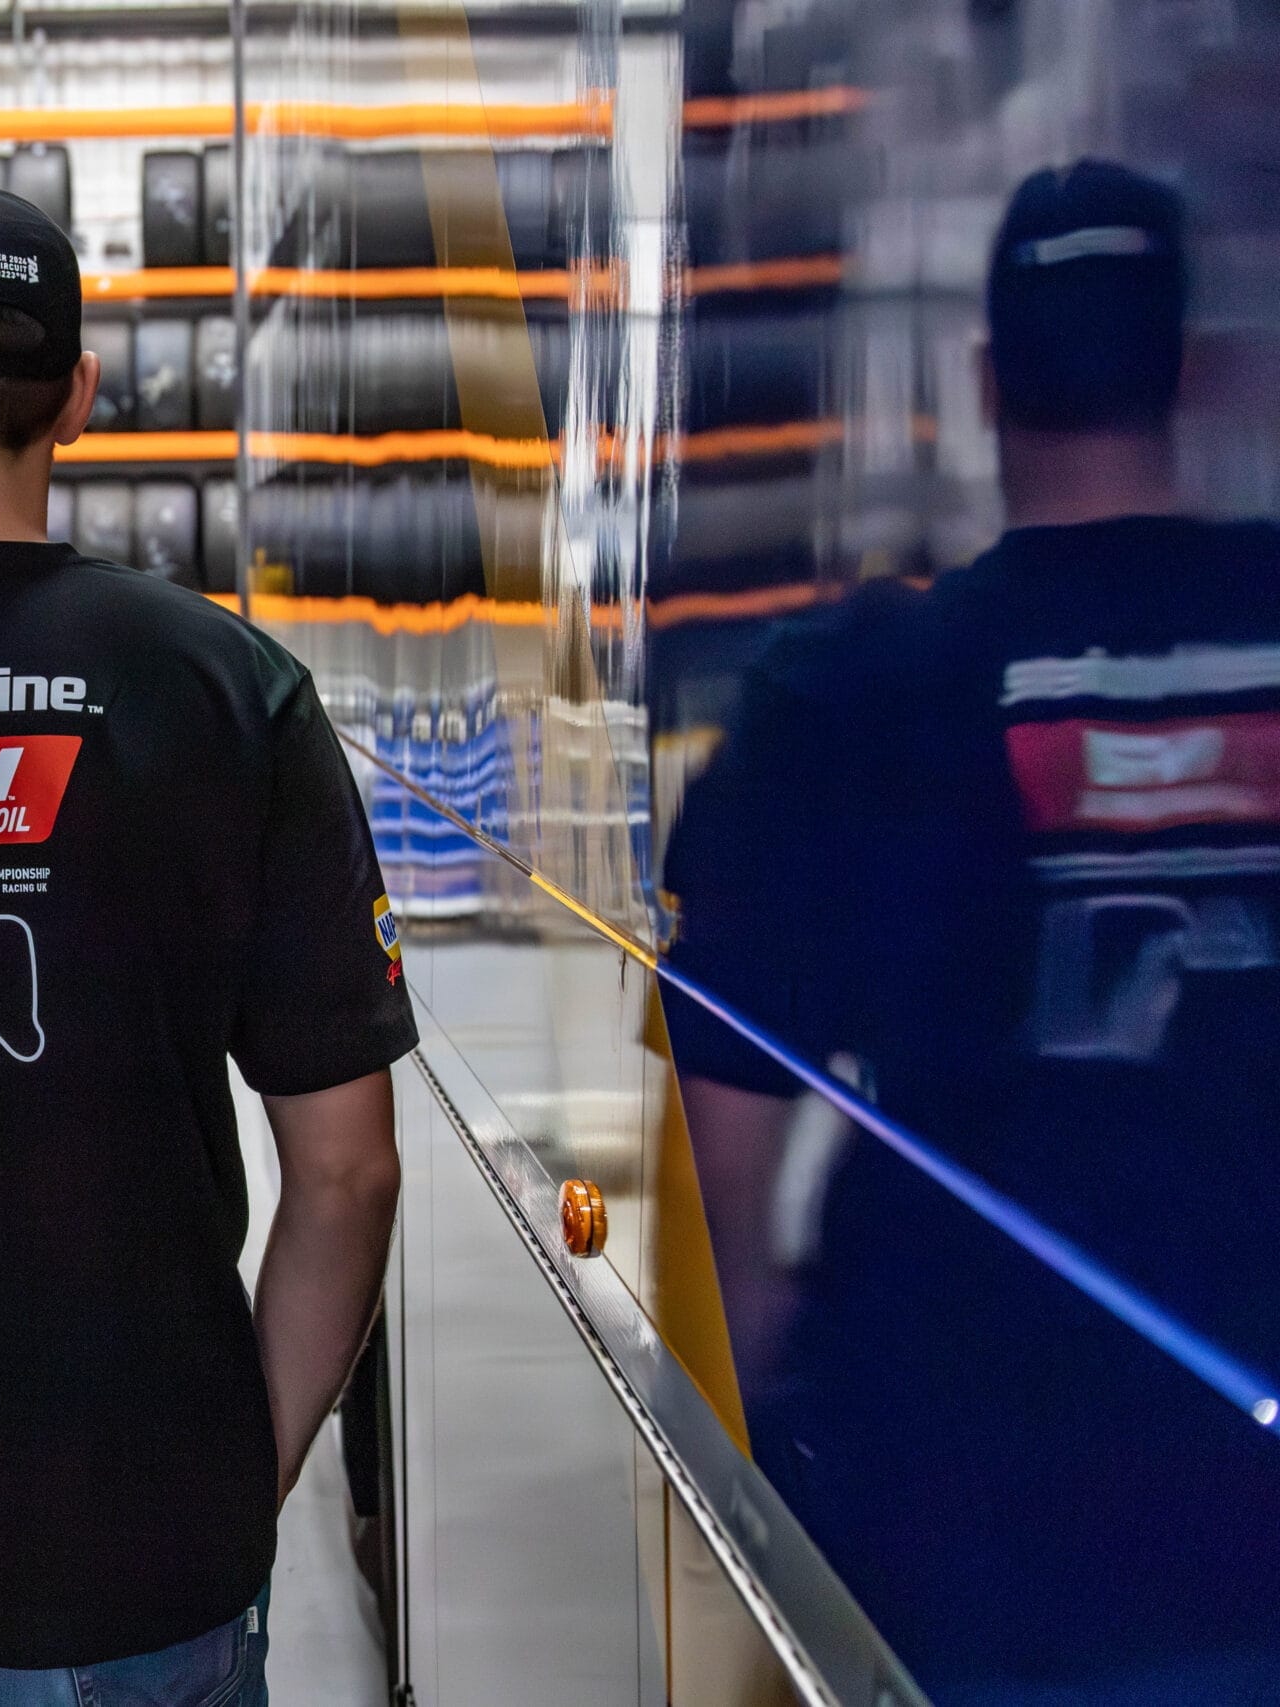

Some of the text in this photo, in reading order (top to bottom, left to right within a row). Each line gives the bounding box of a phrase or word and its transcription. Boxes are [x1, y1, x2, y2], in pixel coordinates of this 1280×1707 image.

[9, 255, 27, 265] 2024
[2, 883, 35, 893] RACING
[37, 883, 48, 893] UK
